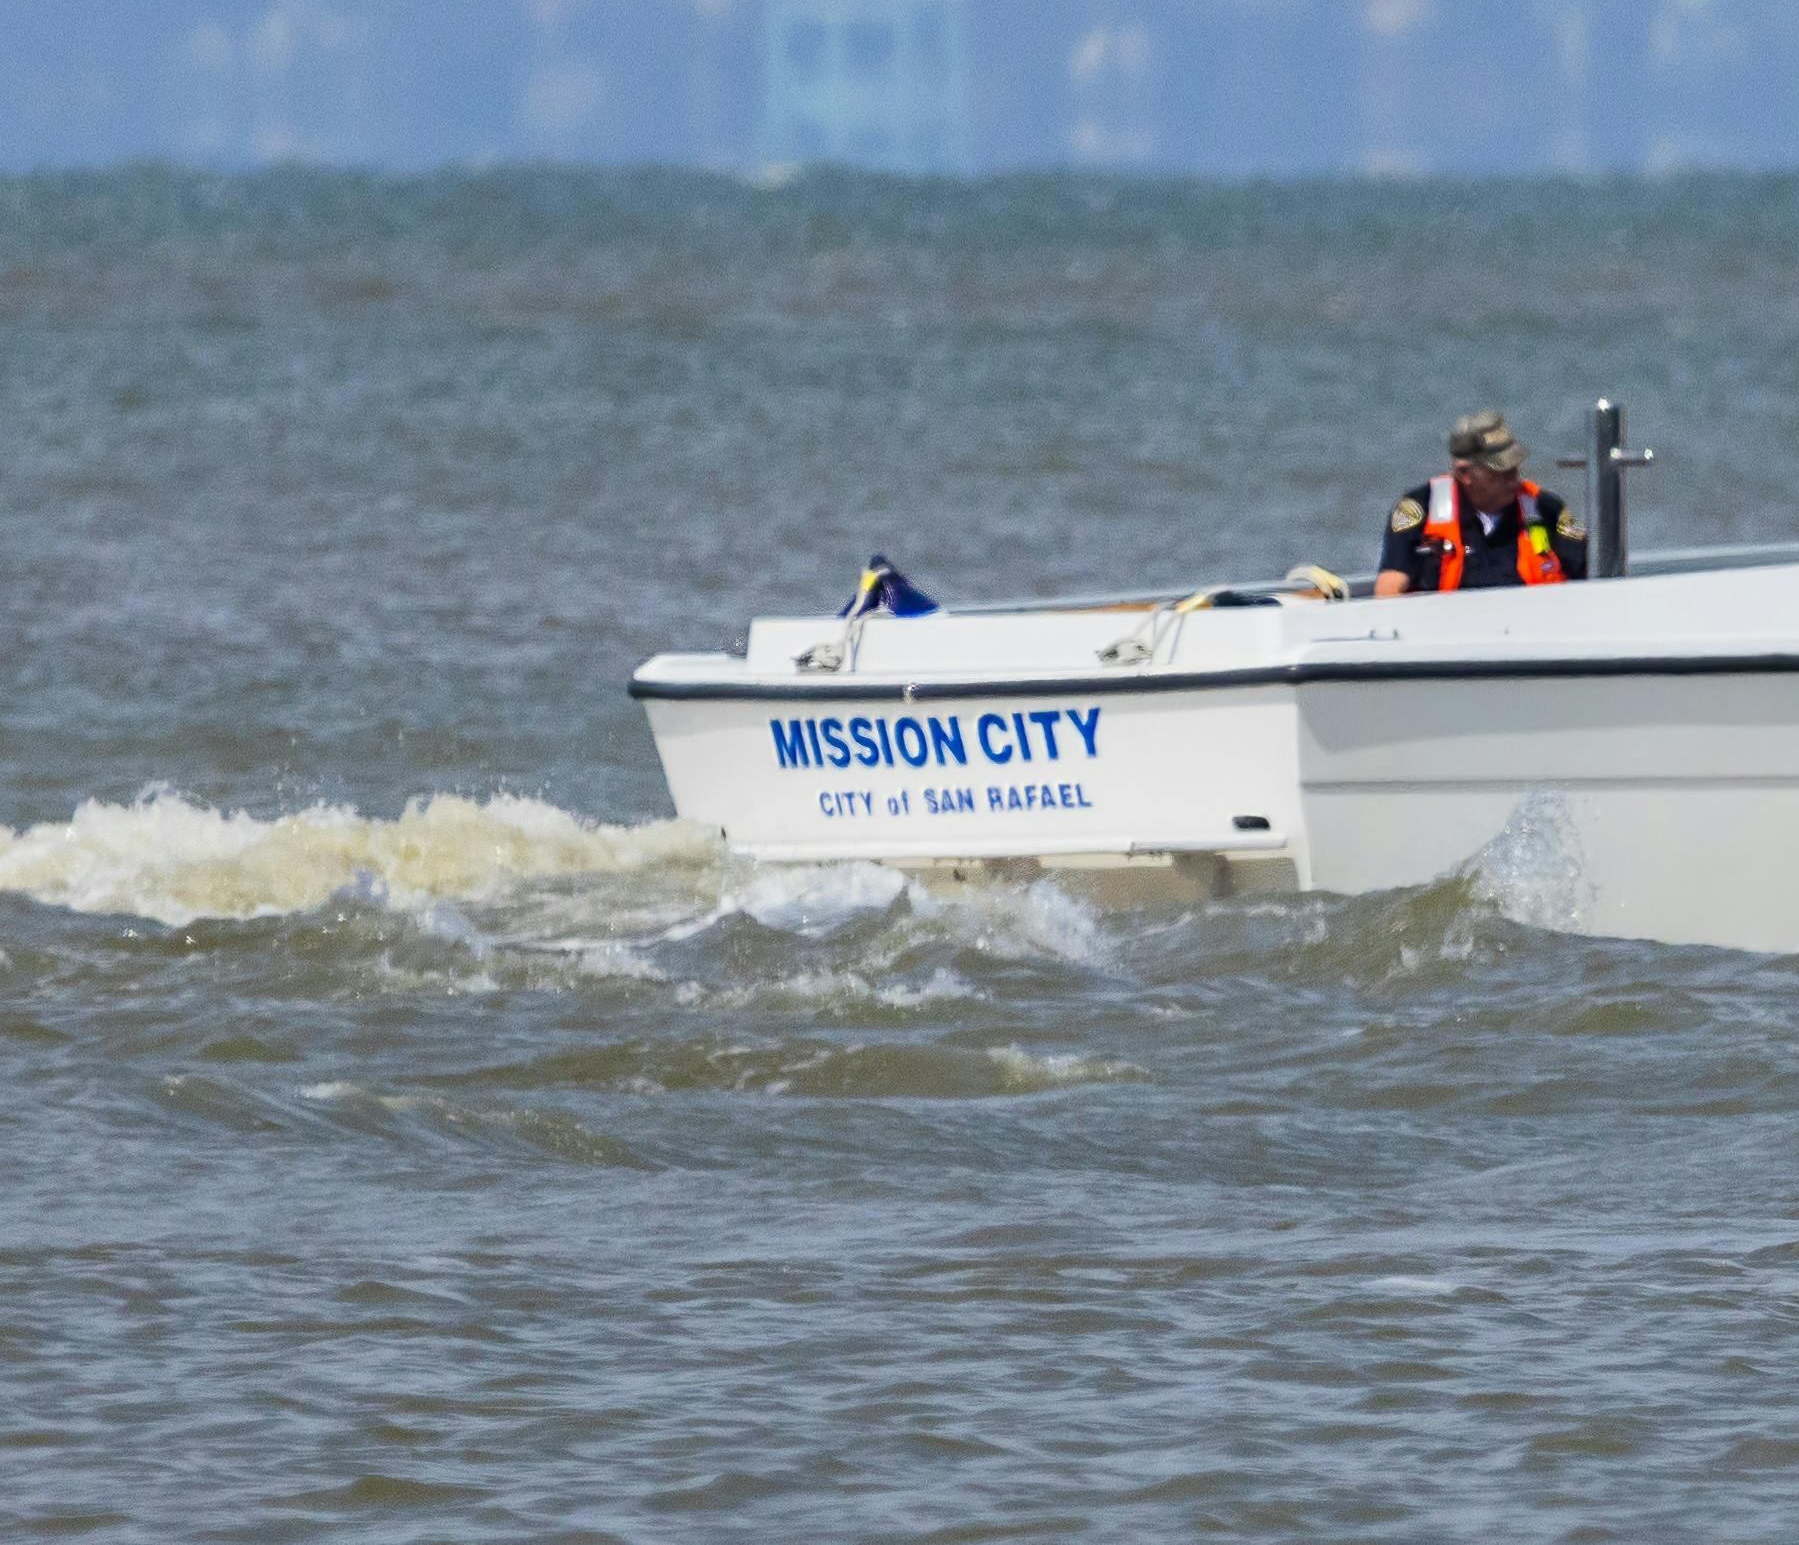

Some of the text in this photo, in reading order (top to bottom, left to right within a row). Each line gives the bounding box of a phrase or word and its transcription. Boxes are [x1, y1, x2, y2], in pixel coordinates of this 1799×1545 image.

[769, 706, 1102, 769] MISSION CITY
[818, 782, 1094, 818] CITY of SAN RAFAEL
